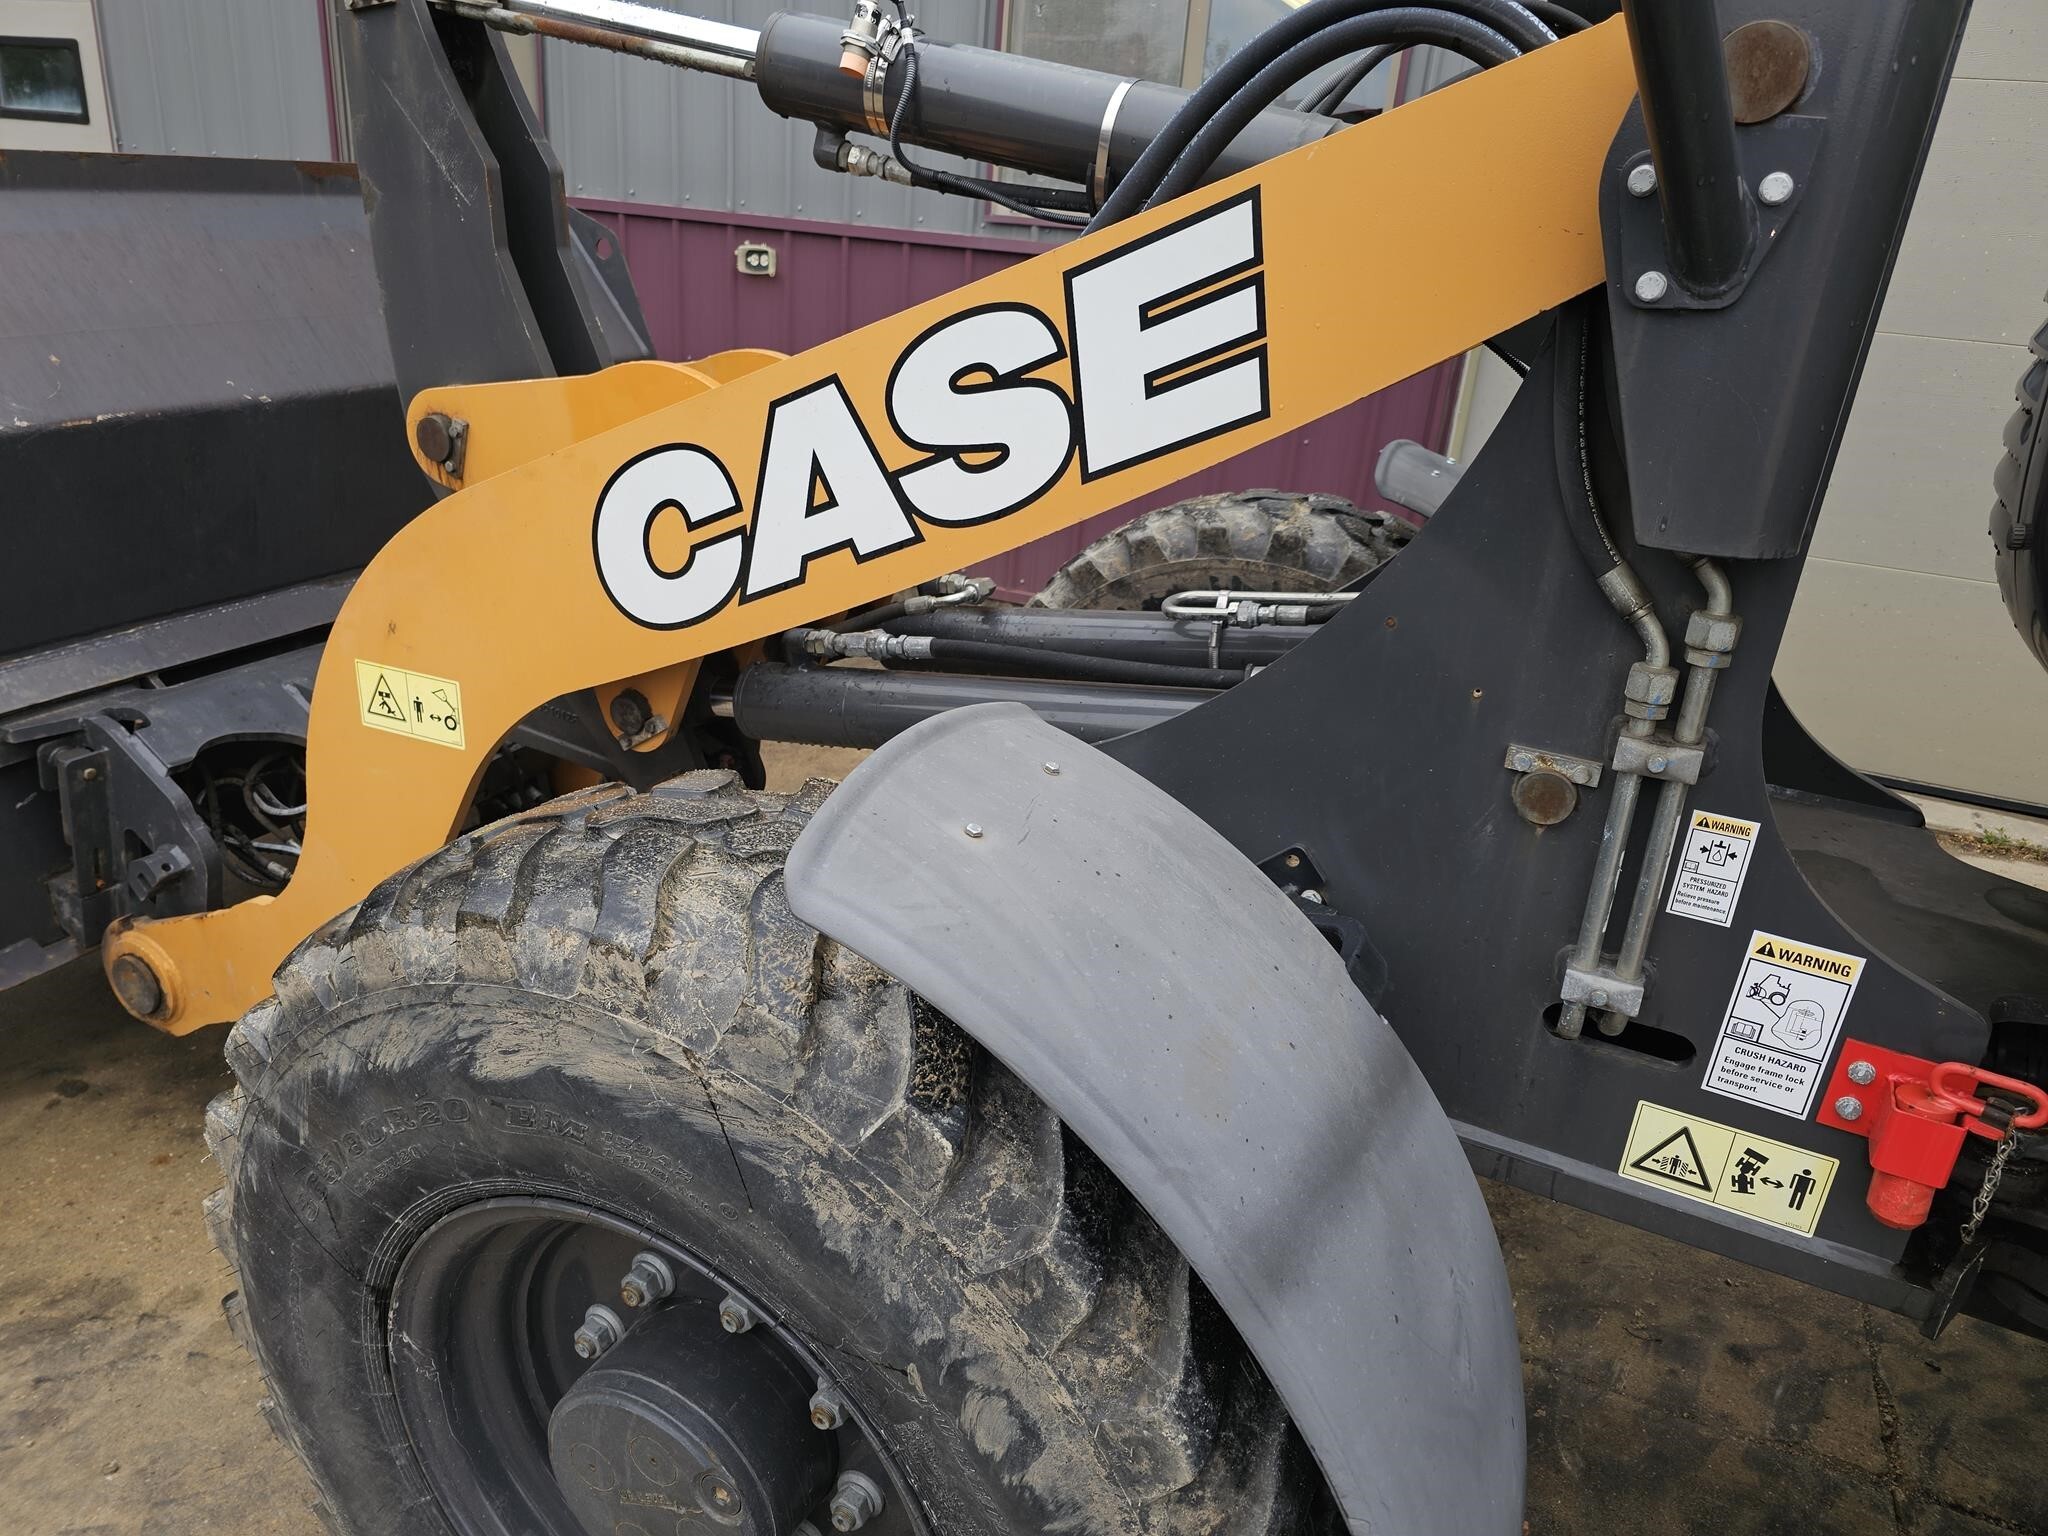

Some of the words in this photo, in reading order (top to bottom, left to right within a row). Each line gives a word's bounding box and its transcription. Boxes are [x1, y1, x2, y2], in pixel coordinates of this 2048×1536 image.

[592, 184, 1270, 631] CASE
[1711, 819, 1751, 837] WARNING
[1682, 882, 1705, 892] SYSTEM
[1706, 887, 1729, 898] HAZARD
[1689, 876, 1727, 889] PRESSURIZED
[1675, 897, 1691, 906] before
[1692, 902, 1726, 915] maintenance.
[1676, 890, 1696, 899] Relieve
[1696, 896, 1720, 905] pressure
[1778, 948, 1852, 978] WARNING
[1734, 1046, 1766, 1062] CRUSH
[1767, 1056, 1807, 1073] HAZARD
[1720, 1065, 1749, 1080] before
[1750, 1076, 1783, 1090] service
[1723, 1055, 1756, 1071] Engage
[1757, 1066, 1783, 1080] frame
[1785, 1074, 1805, 1086] lock
[1717, 1075, 1758, 1093] transport.
[506, 1104, 589, 1144] EM
